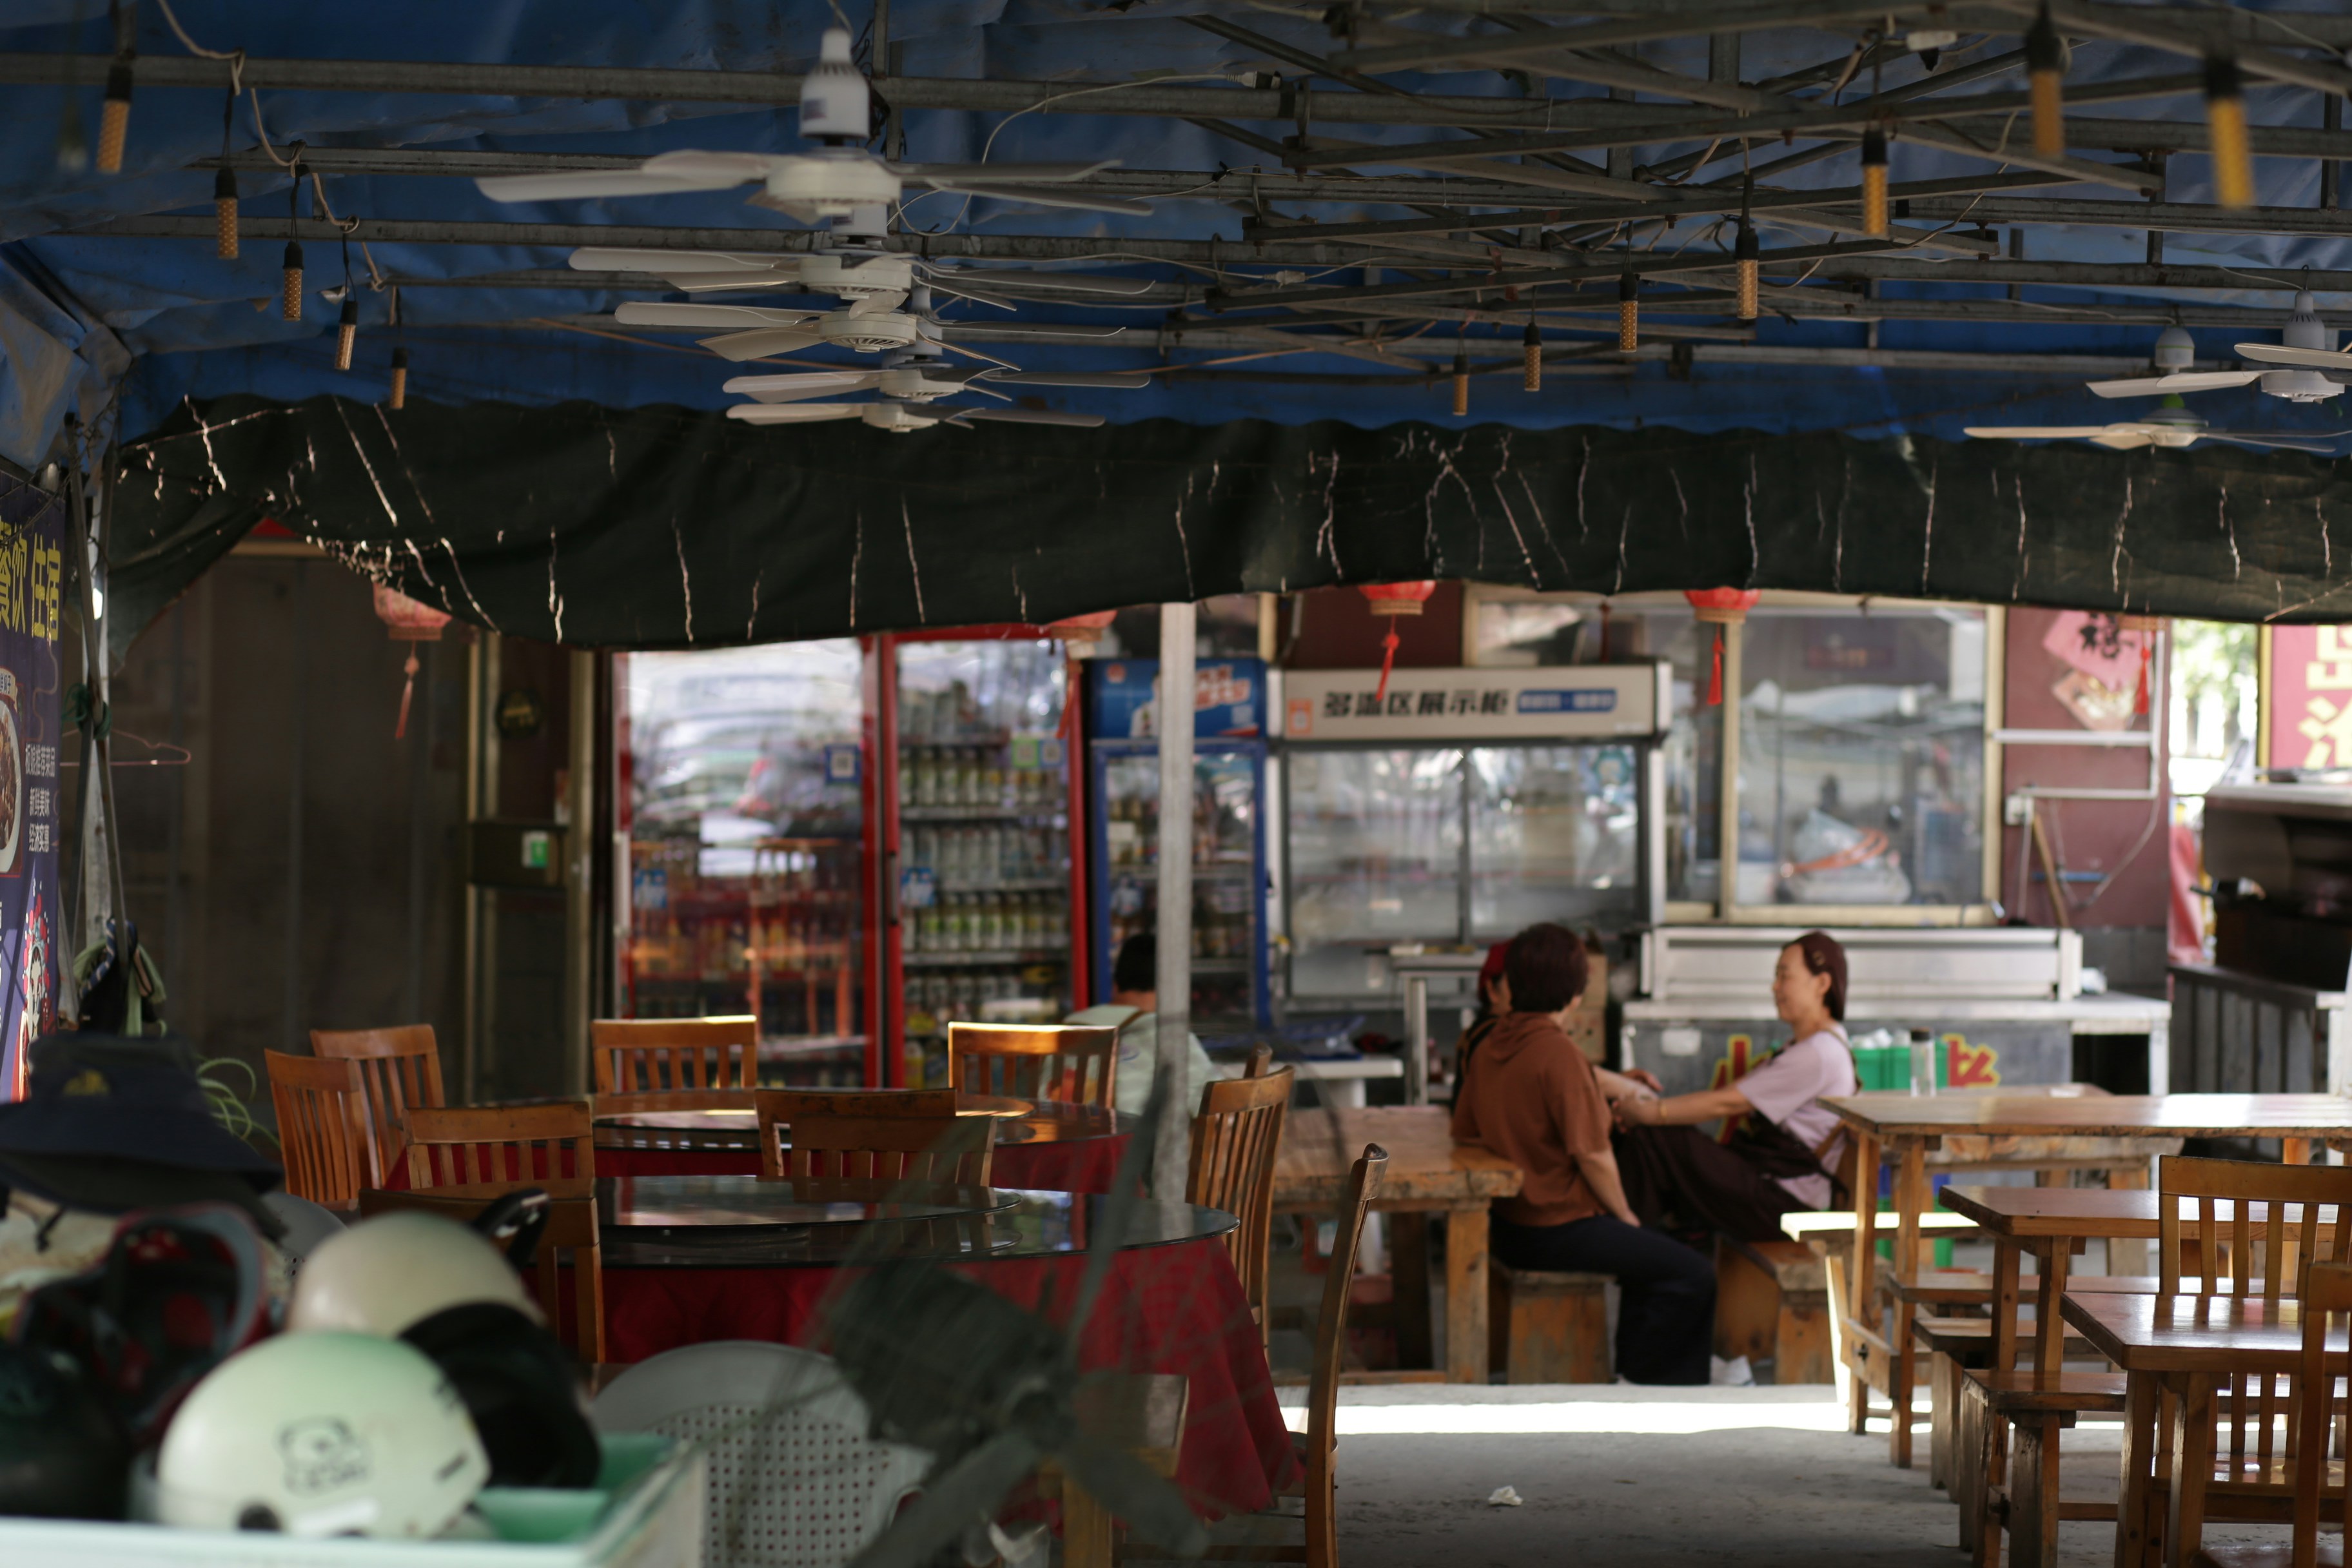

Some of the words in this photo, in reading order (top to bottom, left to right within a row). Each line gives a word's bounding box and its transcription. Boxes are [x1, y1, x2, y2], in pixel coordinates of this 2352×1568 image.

[31, 532, 61, 641] 住宿
[1323, 690, 1509, 718] 多温区展示柜
[28, 822, 50, 853] 经济实惠
